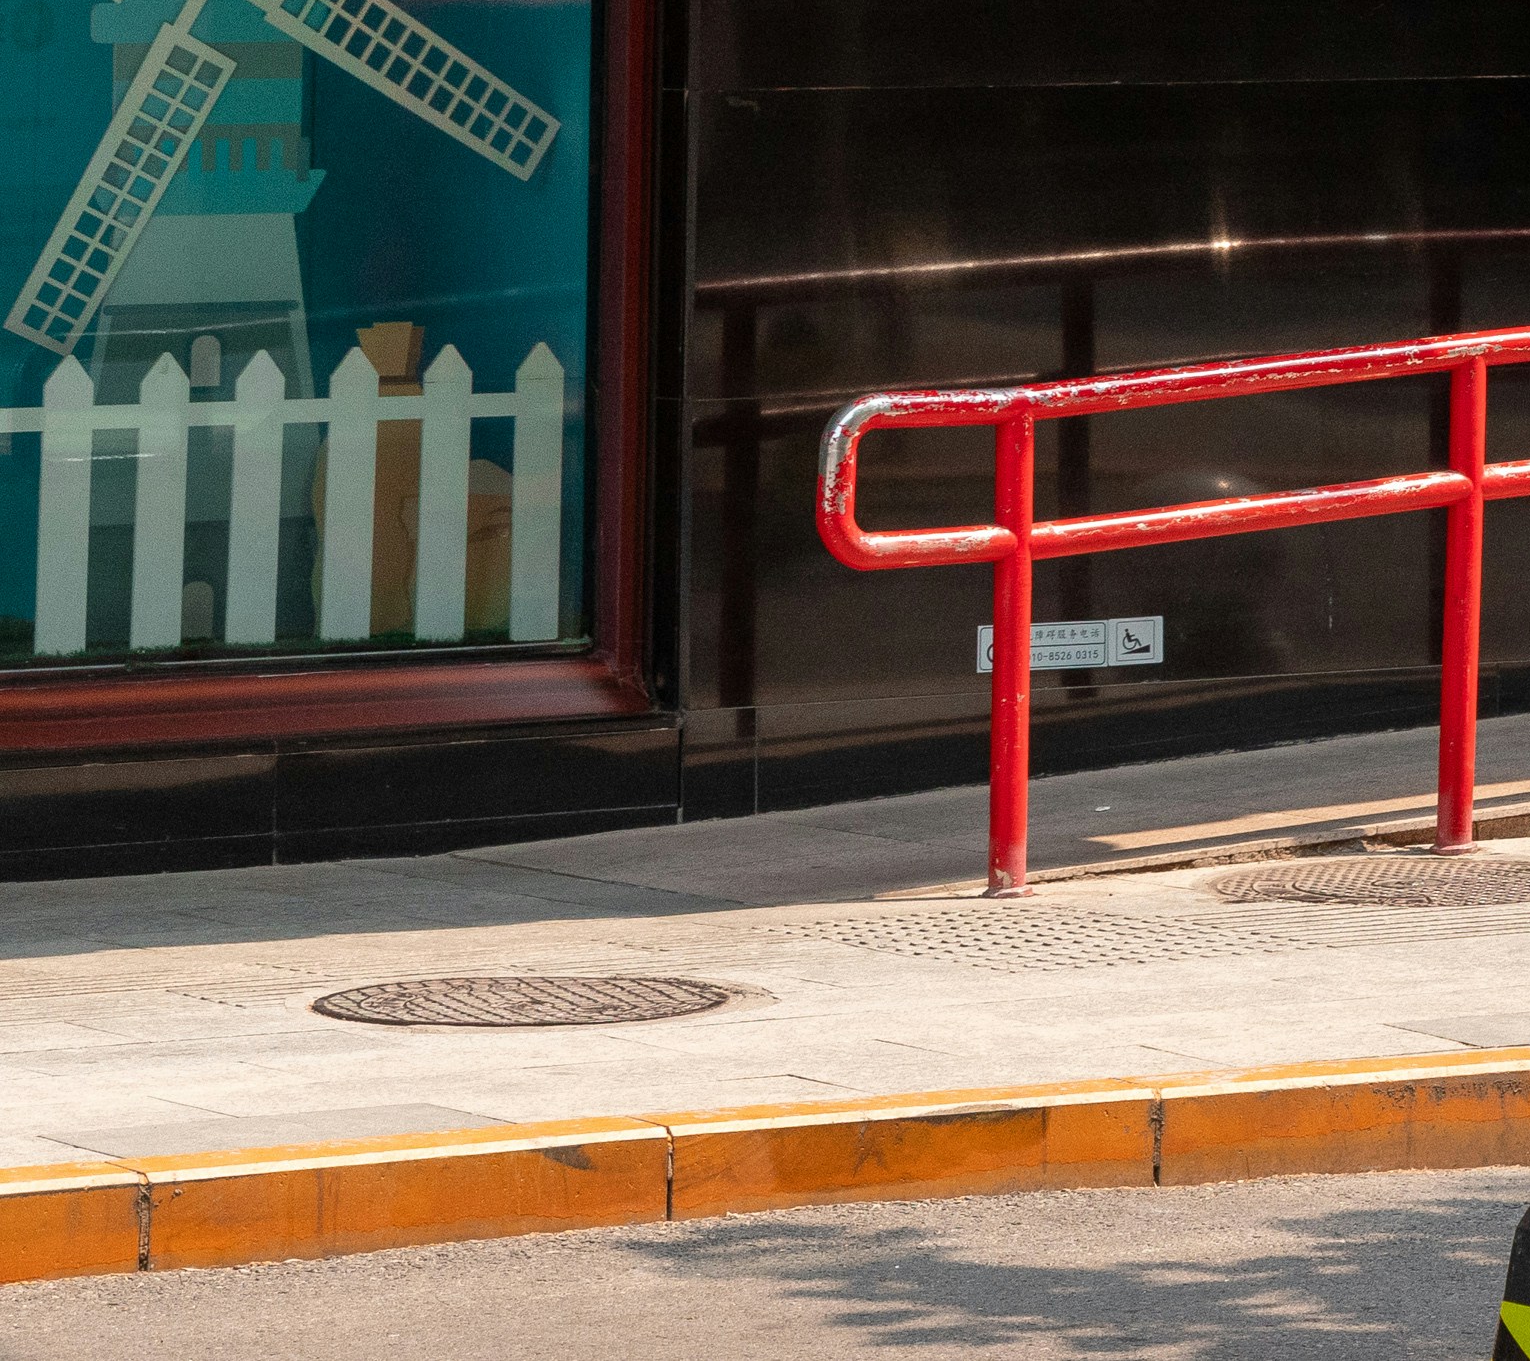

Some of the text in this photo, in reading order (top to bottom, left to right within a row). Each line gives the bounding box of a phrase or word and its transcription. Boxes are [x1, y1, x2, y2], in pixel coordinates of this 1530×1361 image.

[1030, 628, 1100, 642] 障碍服务电话
[1031, 649, 1100, 663] 10-8526 0315
